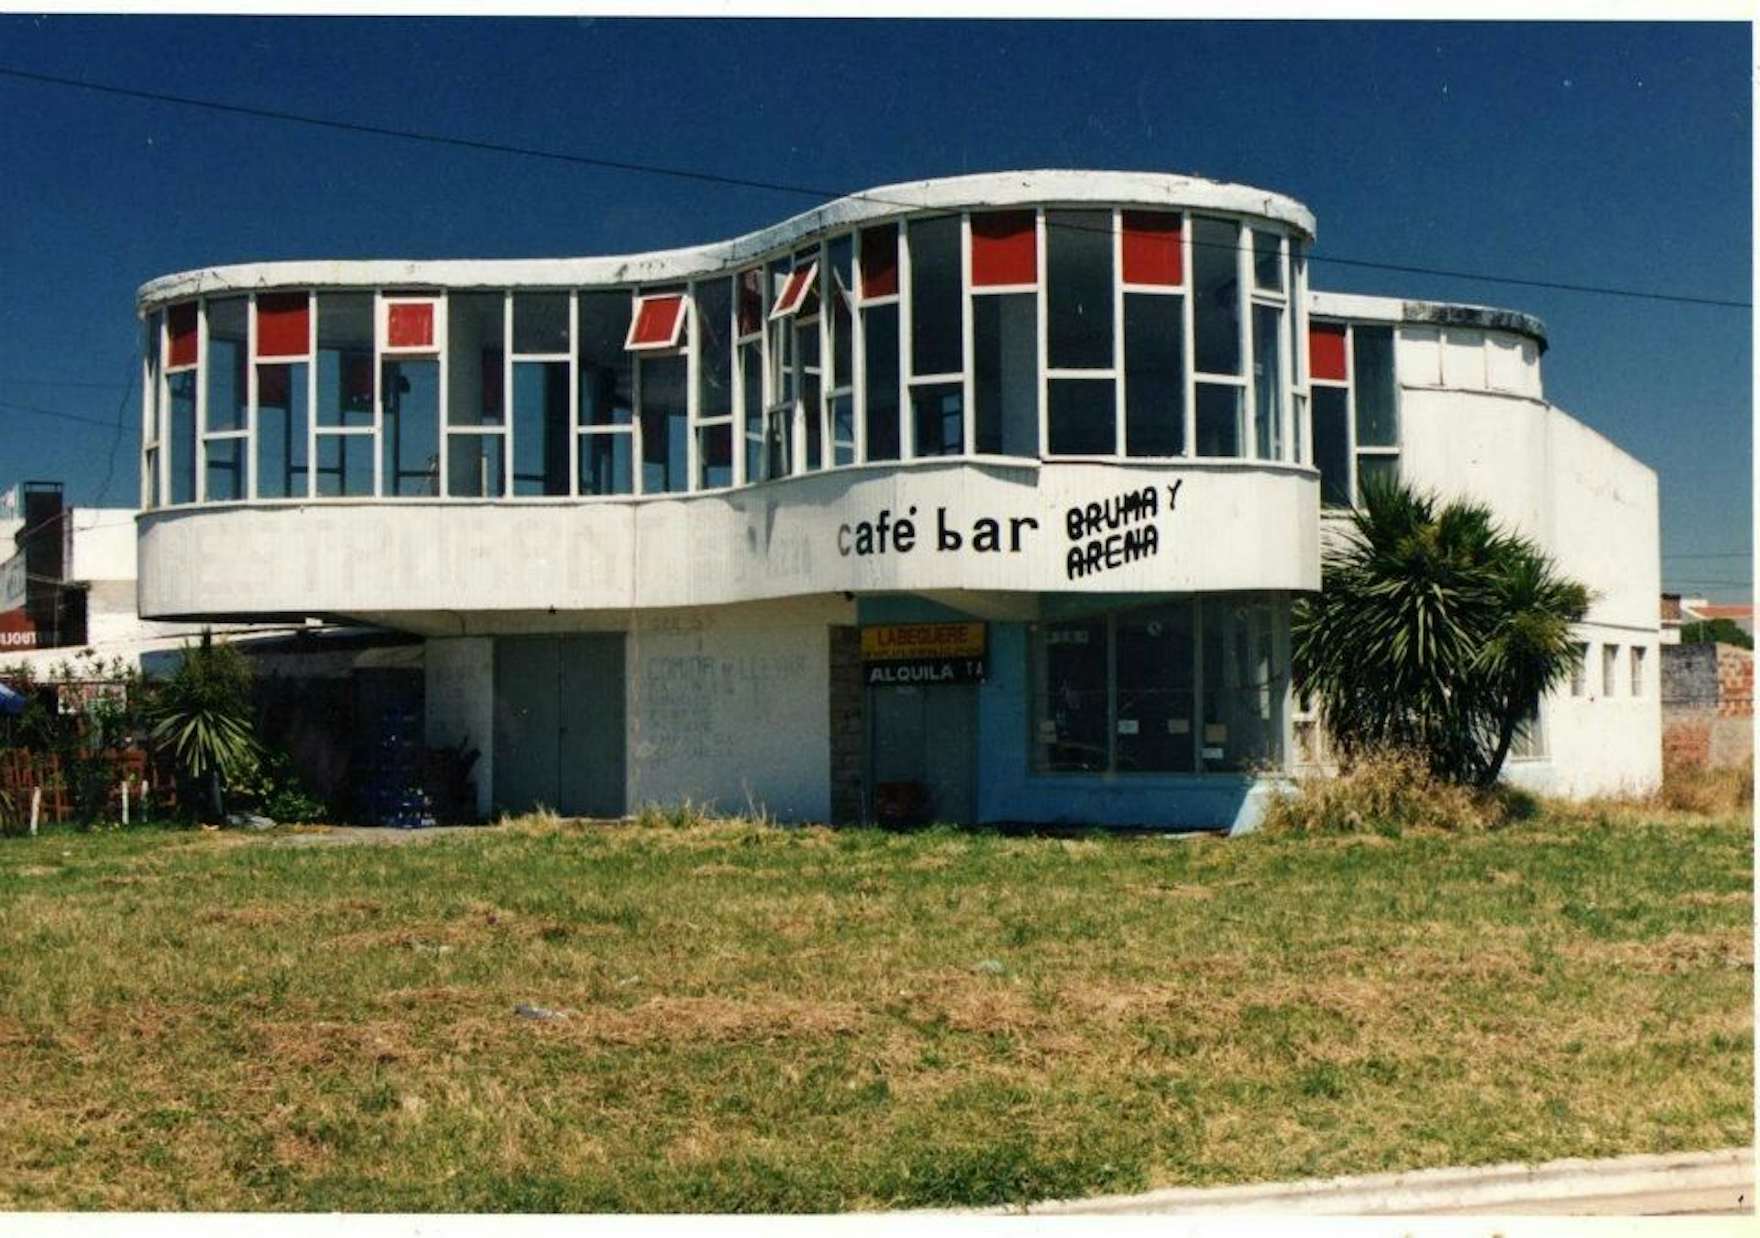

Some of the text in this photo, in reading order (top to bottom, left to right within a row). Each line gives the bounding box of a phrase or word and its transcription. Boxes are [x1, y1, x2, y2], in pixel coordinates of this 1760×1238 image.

[837, 505, 918, 558] café
[936, 506, 1040, 553] bar
[1066, 479, 1182, 542] BRUMA Y
[1066, 524, 1159, 581] ARENA
[869, 665, 954, 683] ALQUILA
